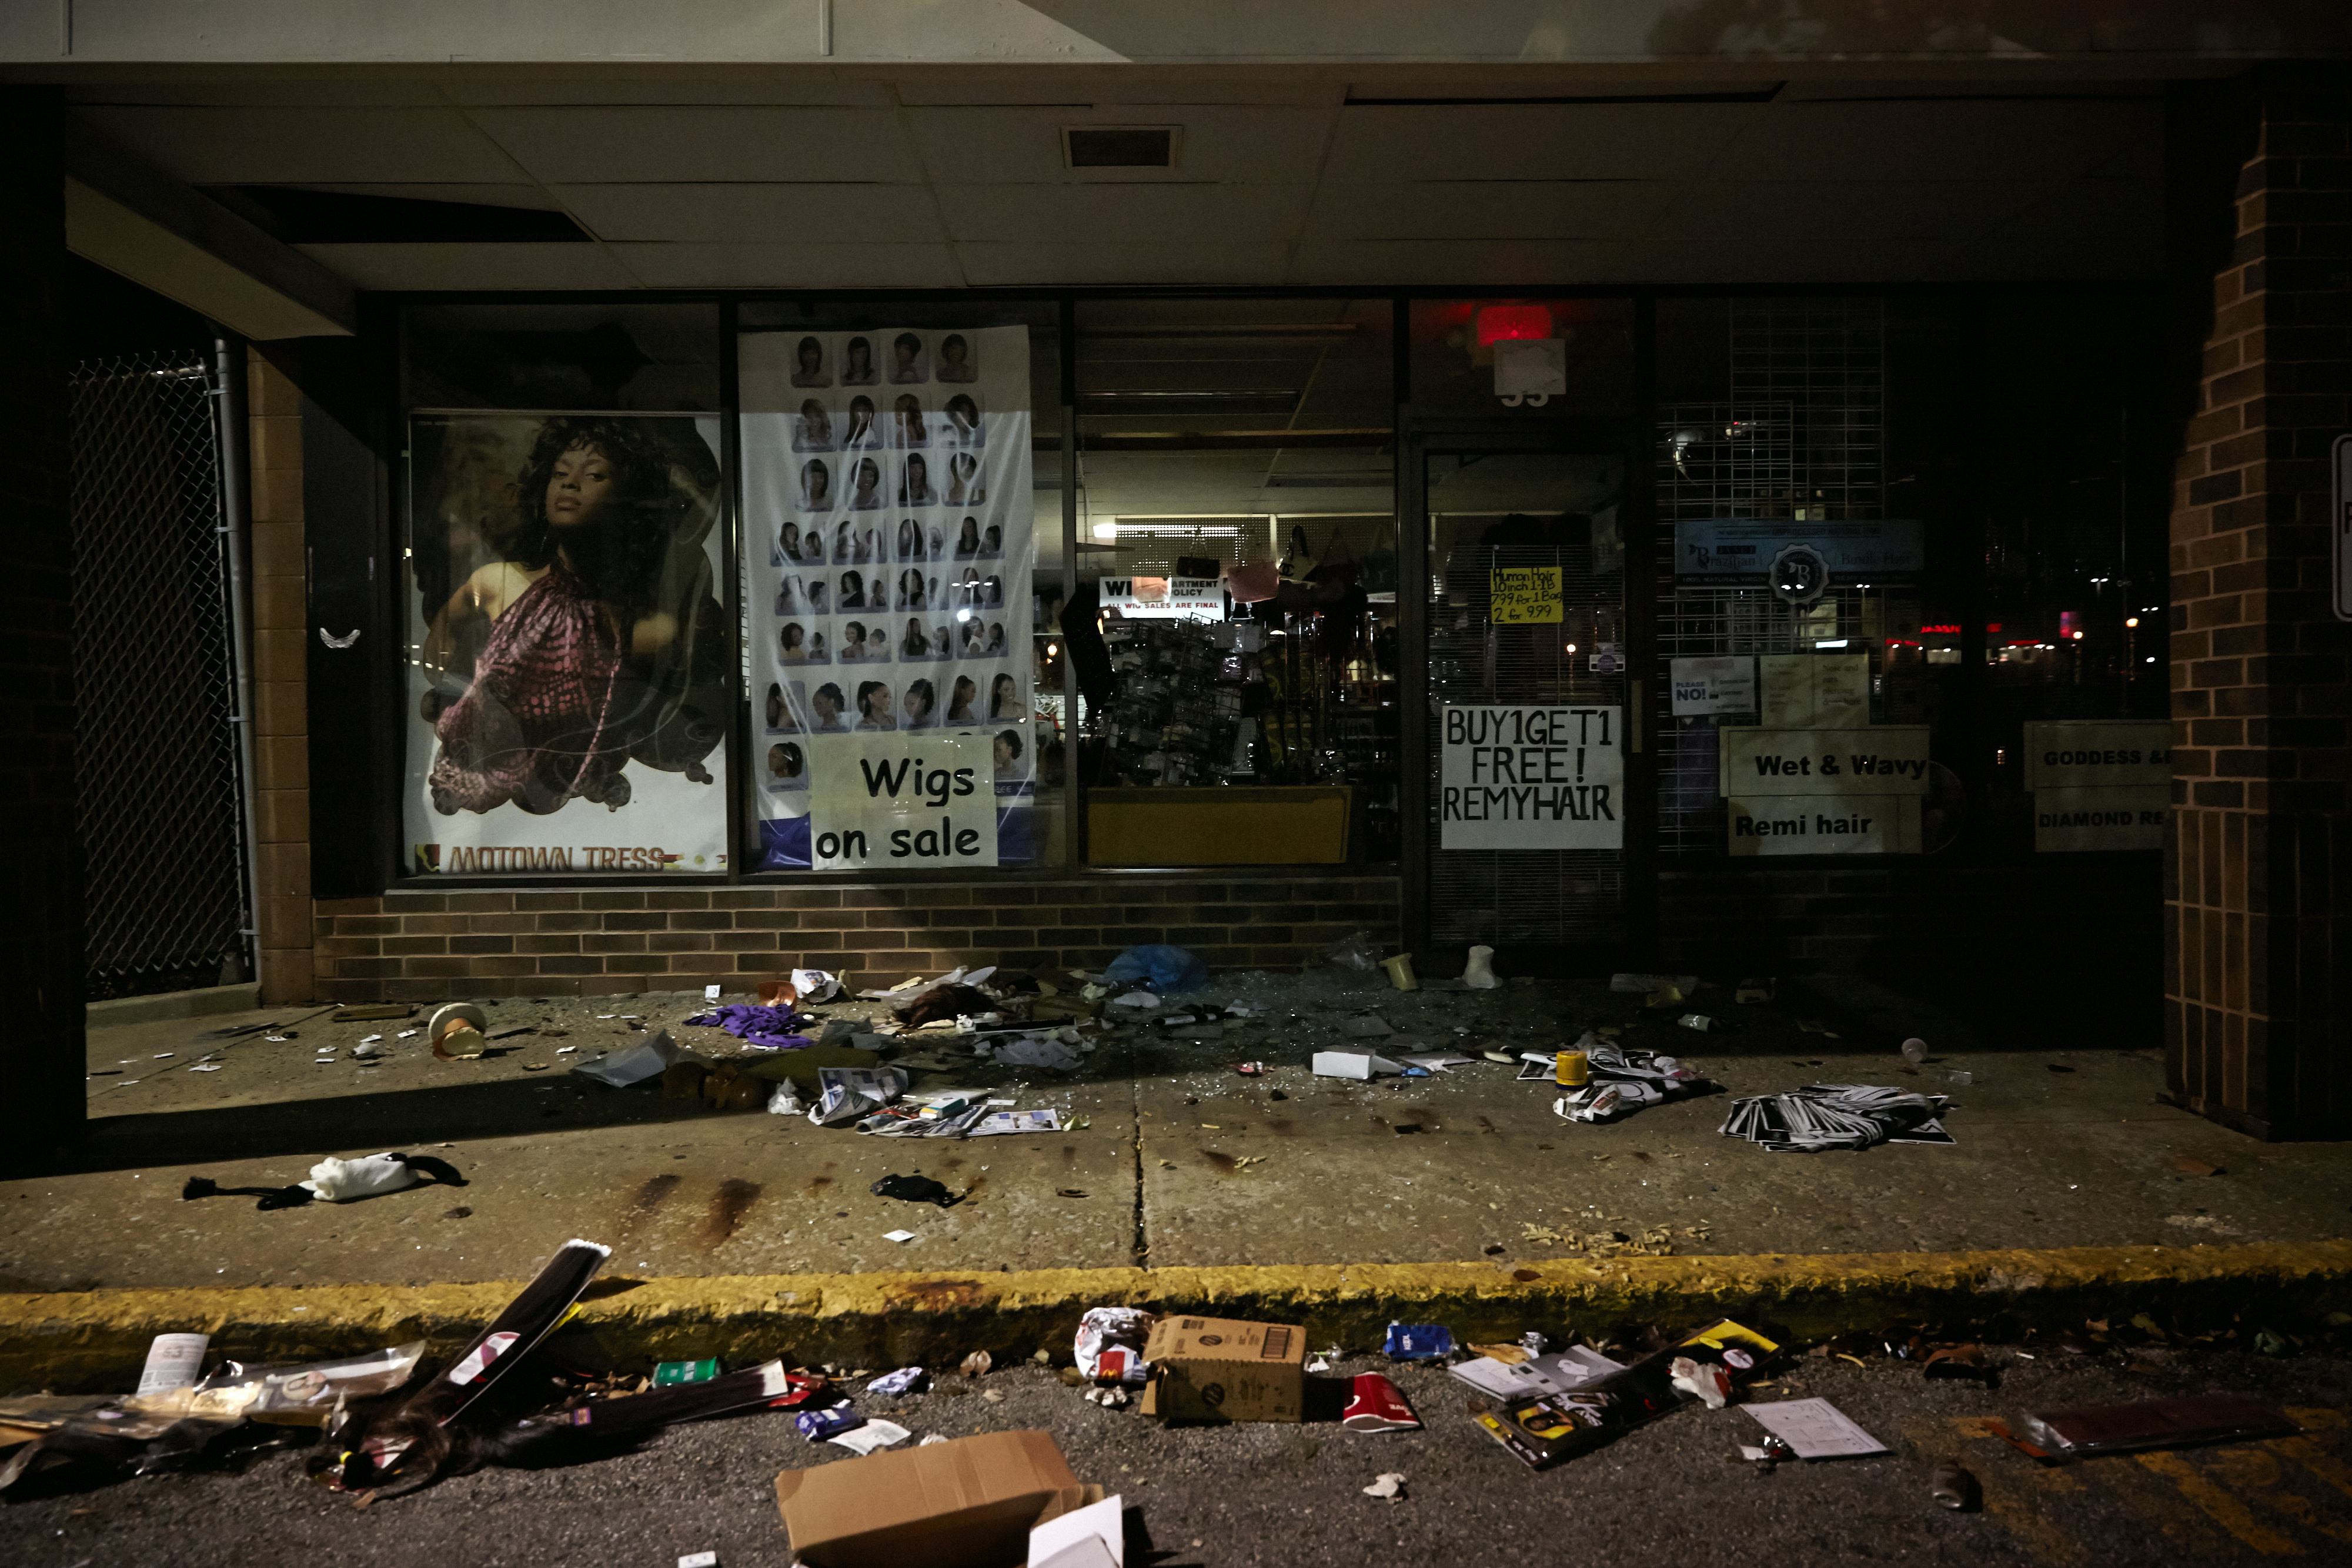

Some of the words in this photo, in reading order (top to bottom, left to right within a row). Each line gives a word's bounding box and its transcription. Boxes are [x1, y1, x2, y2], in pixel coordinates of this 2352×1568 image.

[1493, 568, 1529, 581] Human
[1531, 567, 1555, 580] Hair
[1515, 594, 1532, 604] for
[1533, 592, 1539, 602] 1
[1542, 591, 1563, 603] Bag
[1494, 608, 1504, 622] 2
[1509, 609, 1522, 620] for
[1527, 605, 1551, 618] 9.99
[1676, 688, 1706, 701] NO!
[1472, 747, 1585, 784] FREE!
[1755, 755, 1810, 776] Wet
[1820, 754, 1840, 775] &
[1851, 754, 1927, 780] Wavy
[2043, 750, 2141, 765] GODDESS
[860, 758, 974, 807] Wigs
[1735, 815, 1806, 836] Remi
[1816, 814, 1872, 835] hair
[2039, 811, 2133, 828] DIAMOND
[816, 830, 867, 858] on
[890, 816, 980, 857] sale
[449, 846, 573, 873] MOTOWN
[582, 846, 665, 872] TRESS
